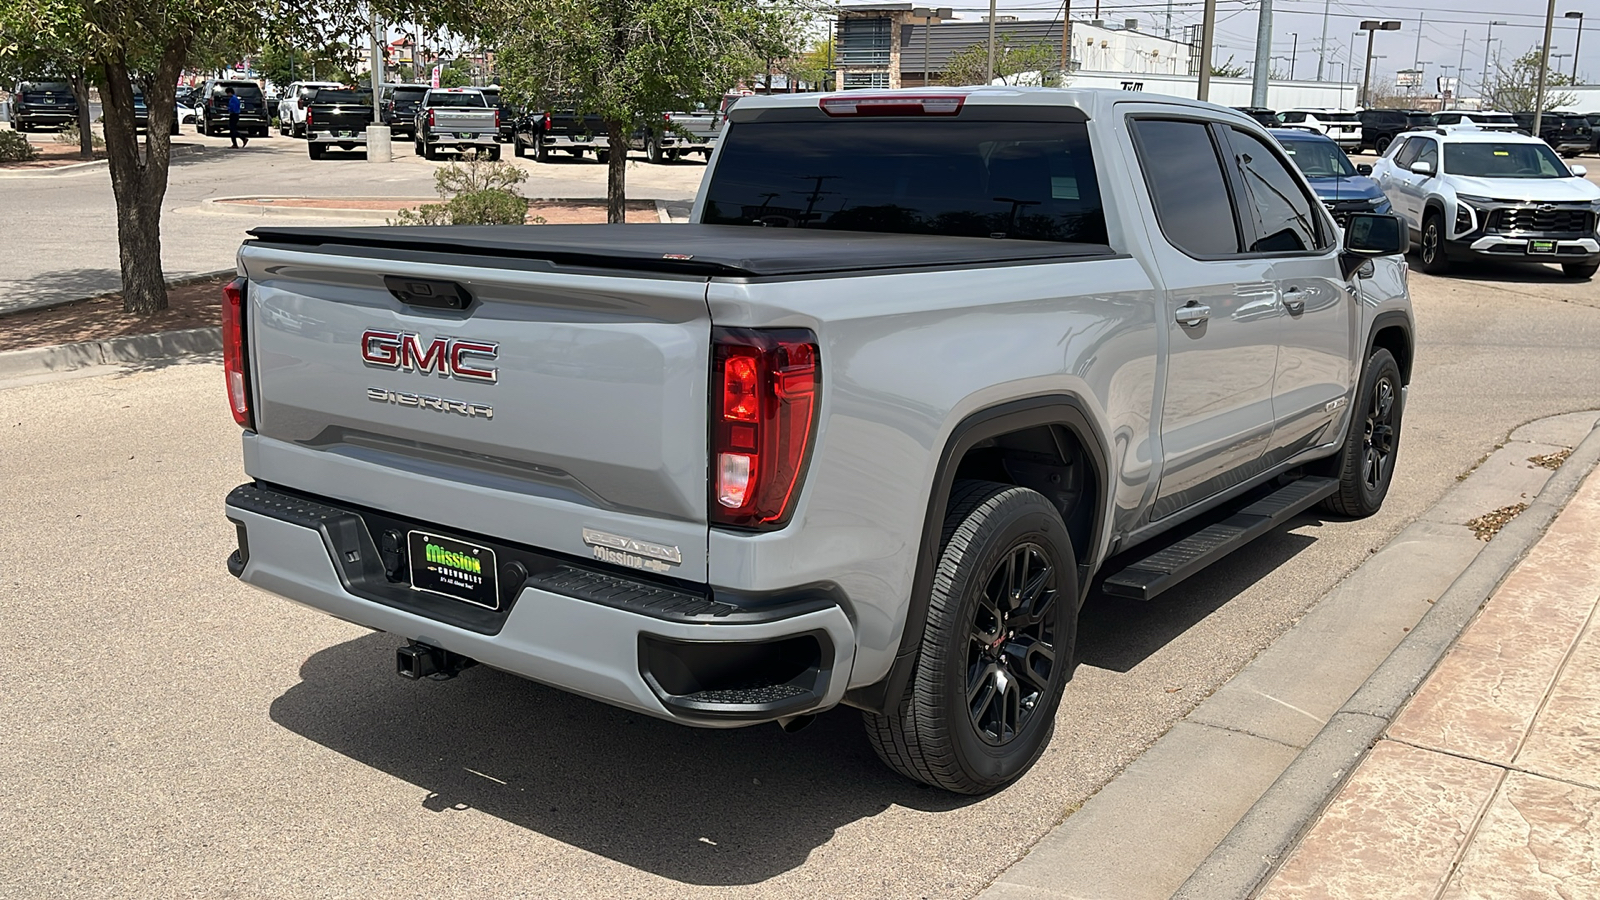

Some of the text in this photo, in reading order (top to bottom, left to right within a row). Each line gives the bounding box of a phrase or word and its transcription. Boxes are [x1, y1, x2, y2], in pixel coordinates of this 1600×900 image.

[362, 329, 499, 385] GMC
[367, 388, 493, 419] SIERRA
[426, 544, 481, 574] Mission
[589, 533, 675, 557] ELEVATION
[437, 566, 482, 584] CHEVROLET
